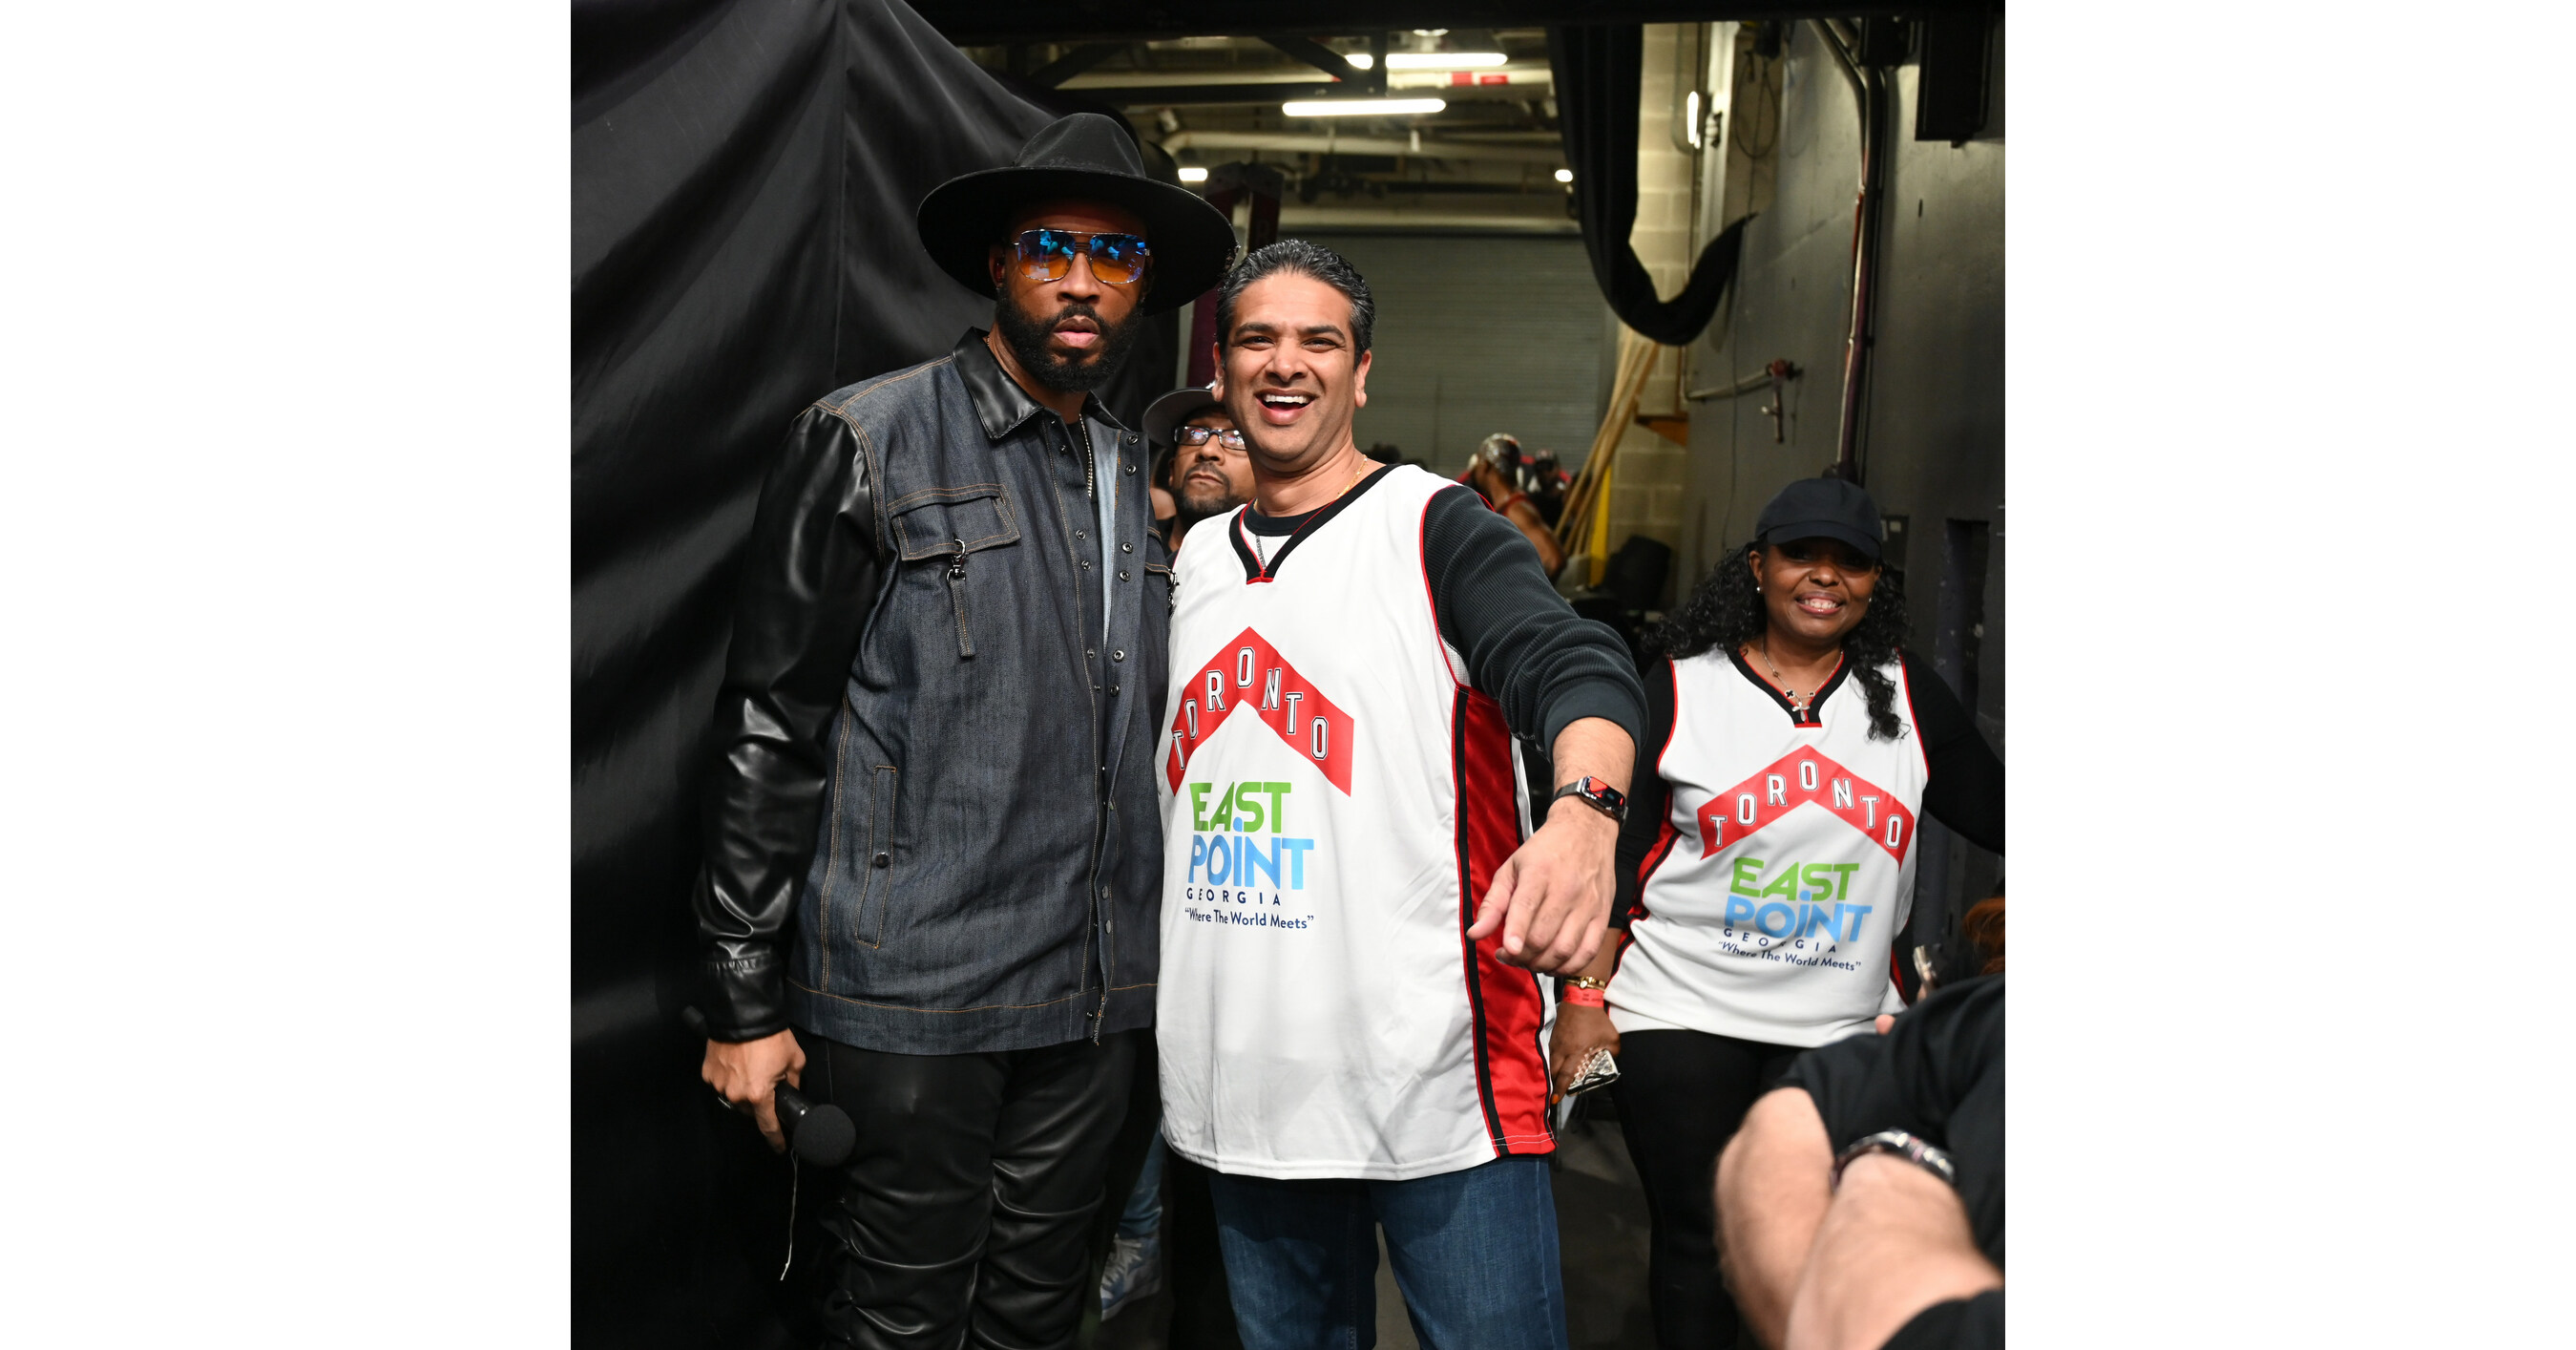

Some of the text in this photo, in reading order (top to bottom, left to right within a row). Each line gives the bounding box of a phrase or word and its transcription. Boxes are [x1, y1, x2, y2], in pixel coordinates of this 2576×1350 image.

[1171, 647, 1330, 770] TORONTO
[1188, 781, 1292, 833] EAST
[1709, 759, 1903, 849] TORONTO
[1187, 816, 1315, 891] POINT
[1186, 887, 1282, 906] GEORGIA
[1729, 856, 1860, 902] EAST
[1213, 909, 1229, 924] The
[1230, 911, 1267, 926] World
[1269, 914, 1314, 929] Meets”
[1760, 949, 1781, 961] The
[1785, 952, 1818, 966] World
[1820, 957, 1861, 972] Meets”
